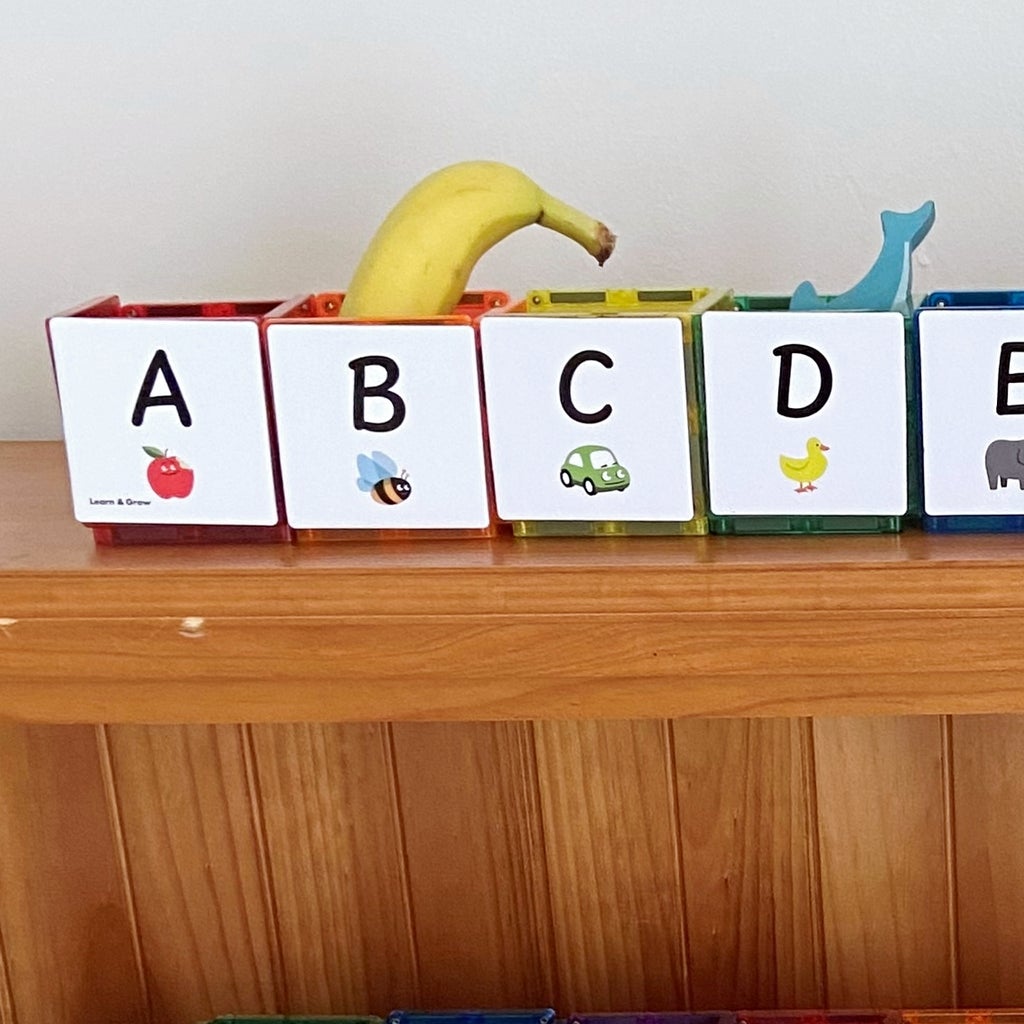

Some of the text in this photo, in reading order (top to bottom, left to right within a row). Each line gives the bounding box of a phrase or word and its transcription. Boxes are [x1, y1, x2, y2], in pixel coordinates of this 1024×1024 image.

[131, 349, 192, 428] A
[348, 355, 406, 433] B
[558, 349, 614, 425] C
[772, 343, 833, 419] D
